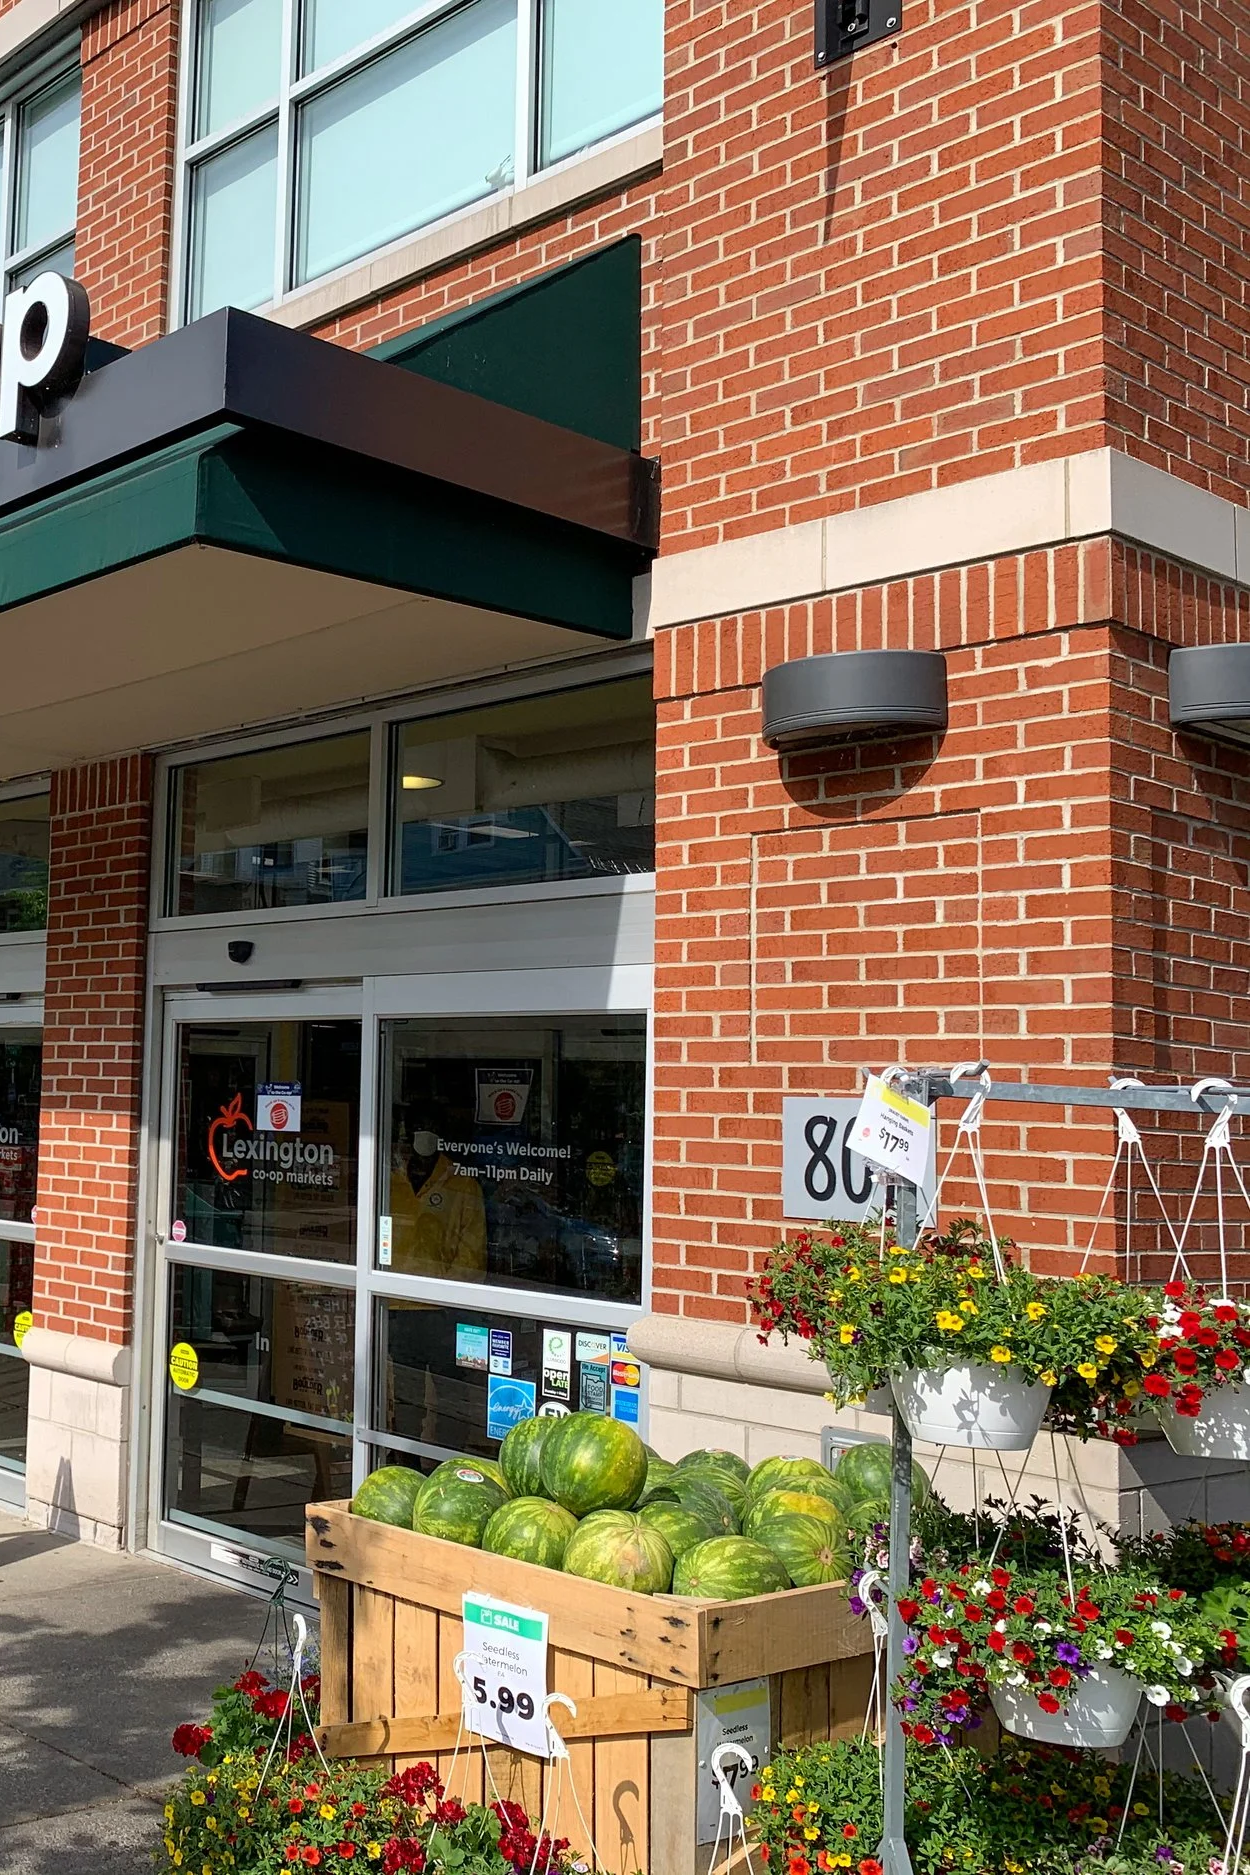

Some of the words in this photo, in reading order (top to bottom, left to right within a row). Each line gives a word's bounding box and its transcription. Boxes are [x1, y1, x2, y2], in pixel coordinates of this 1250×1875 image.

[222, 1133, 334, 1169] Lexington
[436, 1138, 503, 1156] Everyone's
[506, 1142, 572, 1159] Welcome!
[286, 1170, 334, 1186] markets
[452, 1162, 517, 1182] 7am-11pm
[520, 1167, 554, 1186] Daily
[255, 1331, 270, 1353] In
[578, 1339, 607, 1351] DISCOVER
[617, 1343, 631, 1353] VIS
[171, 1356, 198, 1370] CAUTION
[544, 1369, 569, 1381] open
[552, 1379, 569, 1388] LATE
[494, 1615, 520, 1632] SALE
[482, 1641, 520, 1661] Seedless
[482, 1654, 528, 1676] atermelon
[473, 1676, 535, 1720] 5.99
[722, 1723, 749, 1736] Seedless
